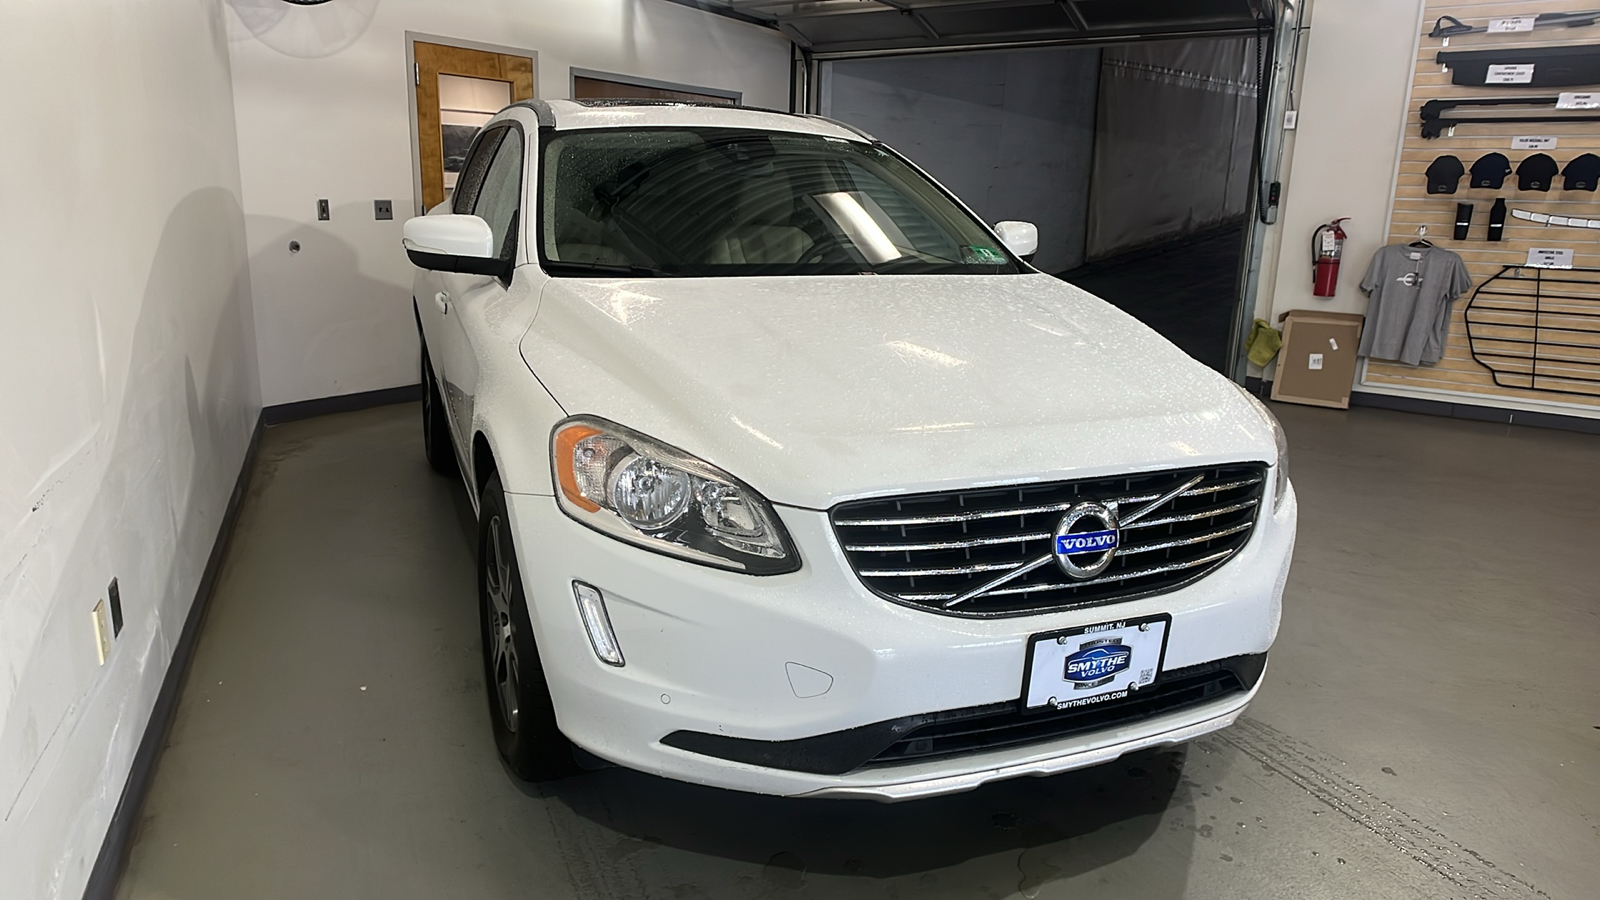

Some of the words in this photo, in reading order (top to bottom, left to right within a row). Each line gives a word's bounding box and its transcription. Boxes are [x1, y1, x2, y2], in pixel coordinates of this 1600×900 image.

[1061, 534, 1116, 550] VOLVO
[1116, 621, 1126, 629] NJ
[1067, 655, 1128, 673] SMYTHE
[1080, 665, 1115, 678] VOLVO
[1057, 690, 1128, 710] SMYTHEVOLVO.COM
